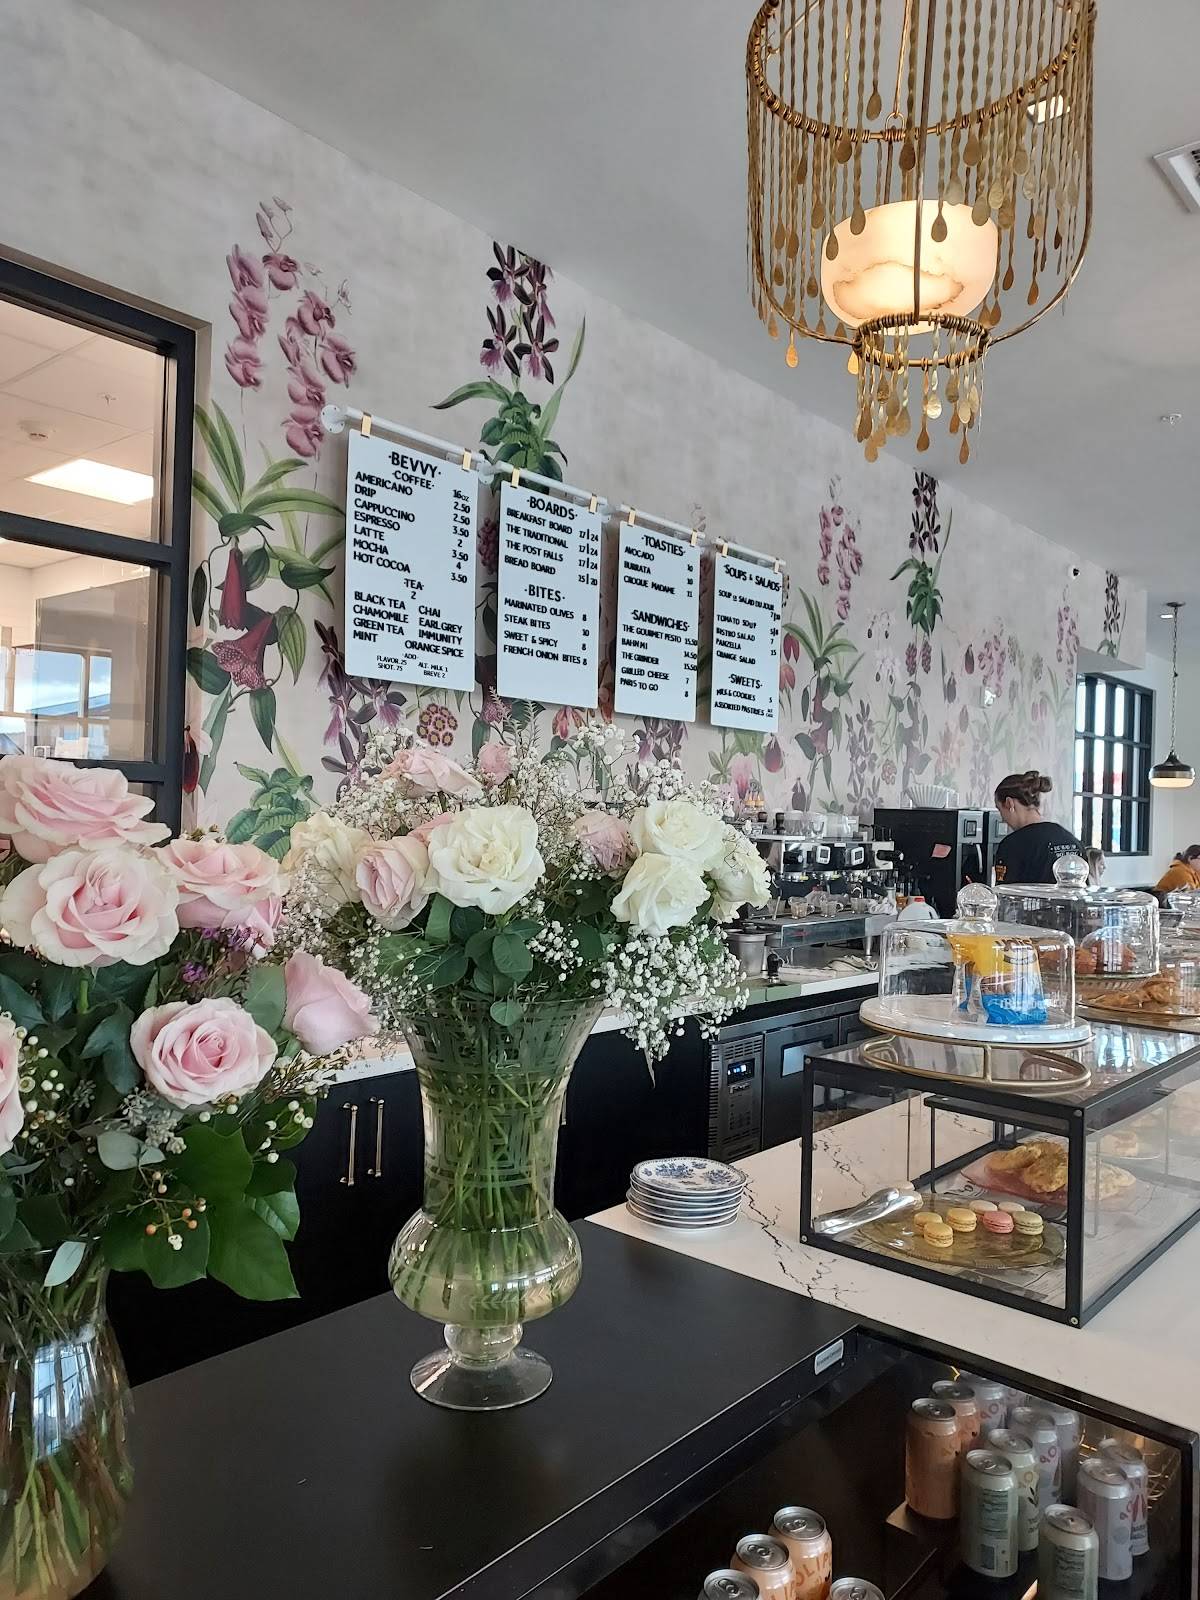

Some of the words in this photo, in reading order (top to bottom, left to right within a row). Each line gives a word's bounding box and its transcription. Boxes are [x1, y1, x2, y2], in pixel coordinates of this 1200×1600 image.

[395, 470, 432, 489] COFFEE
[356, 472, 413, 495] AMERICANO
[454, 502, 470, 513] 2.50
[355, 484, 376, 497] DRIP
[453, 514, 470, 525] 2.50
[530, 496, 575, 520] BOARDS
[354, 511, 400, 531] ESPRESSO
[355, 498, 415, 522] CAPPUCCINO
[453, 526, 469, 537] 3.50
[507, 508, 546, 526] BREAKFAST
[549, 521, 573, 534] BOARD
[354, 524, 384, 541] LATTE
[452, 550, 468, 561] 3.50
[506, 523, 521, 535] THE
[523, 528, 568, 548] TRADITIONAL
[354, 538, 389, 555] MOCHA
[506, 540, 521, 551] THE
[523, 544, 542, 556] POST
[544, 550, 563, 562] FALLS
[625, 546, 654, 561] AVOCADO
[644, 535, 684, 556] TOASTIES
[354, 551, 374, 564] HOT
[376, 557, 410, 573] COCOA
[451, 573, 467, 583] 3.50
[505, 555, 529, 568] BREAD
[531, 562, 556, 575] BOARD
[725, 564, 747, 581] SOUPS
[529, 584, 561, 602] BITES
[624, 576, 648, 587] CROQUE
[651, 582, 676, 594] MADAME
[354, 591, 385, 606] BLACK
[388, 598, 406, 610] TEA
[411, 591, 416, 600] 2
[719, 590, 732, 598] SOUP
[739, 596, 754, 606] SALAD
[353, 605, 408, 623] CHAMOMILE
[419, 605, 440, 618] CHAI
[504, 598, 547, 614] MARINATED
[550, 608, 574, 619] OLIVES
[353, 618, 385, 631] GREEN
[386, 623, 404, 636] TEA
[419, 618, 440, 630] EARL
[441, 622, 462, 634] GREY
[504, 614, 528, 626] STEAK
[530, 619, 550, 630] BITES
[582, 629, 590, 637] 10
[633, 610, 688, 632] SANDWICHES
[717, 614, 740, 625] TOMATO
[743, 620, 756, 629] SOUP
[353, 630, 378, 642] MINT
[419, 629, 462, 645] IMMUNITY
[504, 630, 529, 642] SWEET
[532, 636, 536, 644] &
[538, 637, 558, 648] SPICY
[623, 624, 635, 633] THE
[636, 628, 663, 639] GOURMET
[664, 633, 682, 643] PESTO
[737, 632, 755, 641] SALAD
[405, 640, 440, 654] ORANGE
[442, 647, 464, 658] SPICE
[504, 645, 533, 656] FRENCH
[536, 650, 558, 661] ONION
[562, 654, 580, 664] BITES
[622, 651, 633, 660] THE
[739, 656, 756, 664] SALAD
[424, 670, 440, 678] BREVE
[622, 667, 645, 676] GRILLED
[648, 671, 670, 680] CHEESE
[731, 674, 761, 689] SWEETS
[638, 682, 647, 690] TO
[733, 691, 755, 701] COOKIES
[715, 702, 740, 711] ASSORTED
[741, 705, 764, 716] PASTRIES
